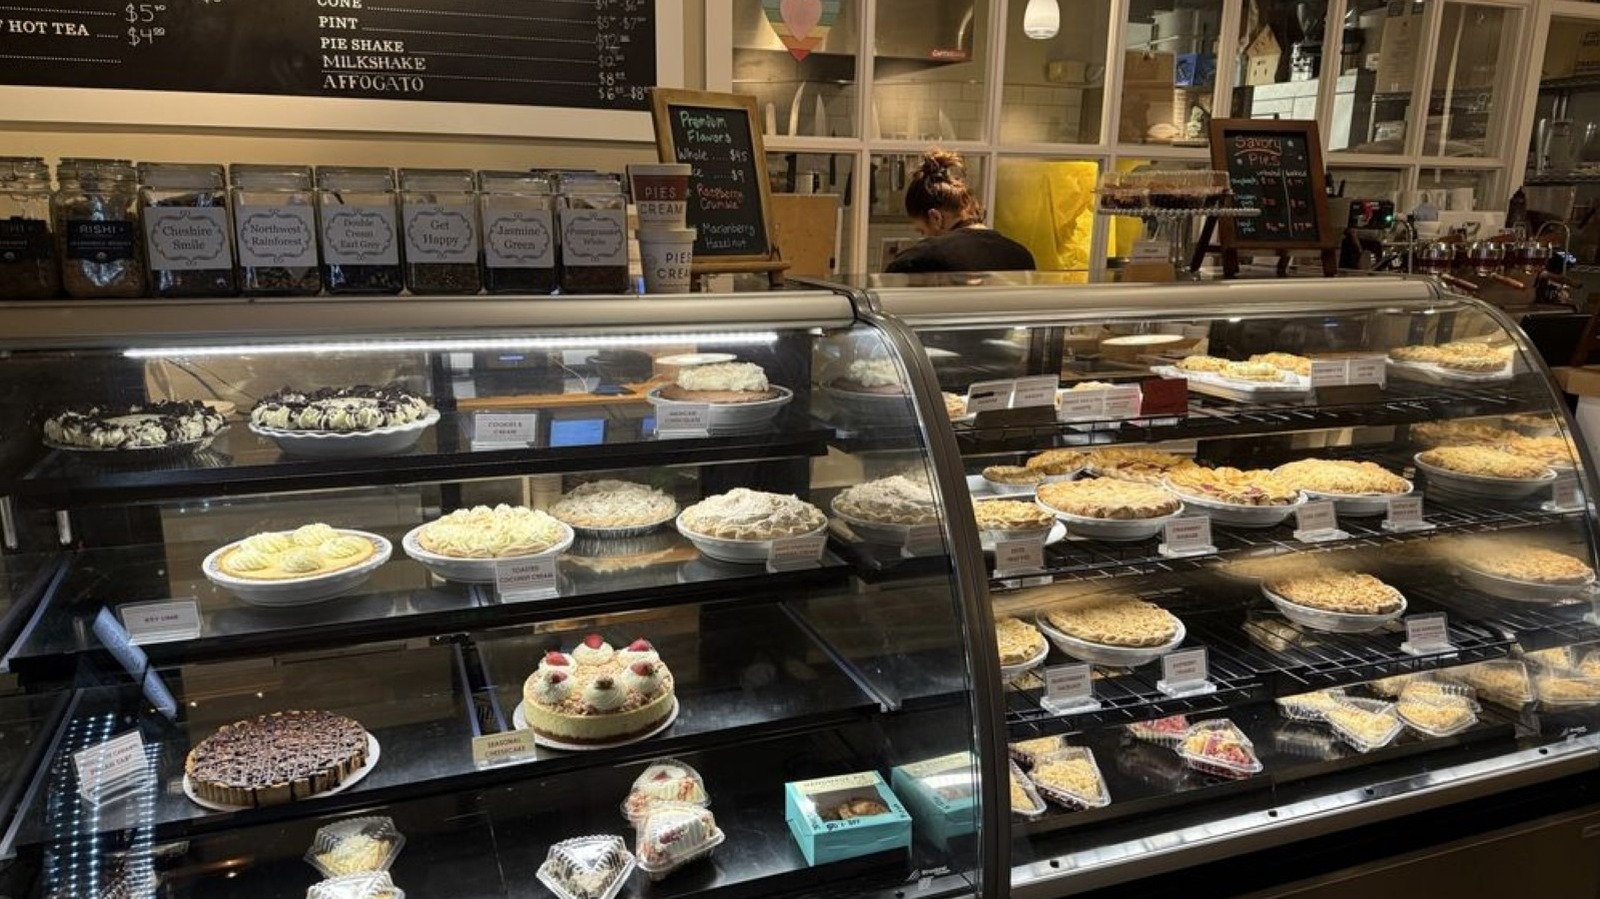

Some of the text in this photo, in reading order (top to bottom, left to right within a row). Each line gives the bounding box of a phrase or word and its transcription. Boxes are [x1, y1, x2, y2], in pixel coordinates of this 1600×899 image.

[8, 20, 47, 34] HOT
[52, 22, 90, 36] TEA
[318, 16, 359, 30] PINT
[320, 37, 404, 53] PIE SHAKE
[322, 55, 426, 70] MILKSHAKE
[323, 75, 424, 92] AFFOGATO
[680, 111, 727, 129] Premium
[687, 131, 732, 144] Flavors
[1234, 135, 1282, 152] Savory
[678, 148, 709, 161] Whole
[645, 187, 677, 199] PIES
[640, 202, 684, 215] CREAM
[79, 224, 116, 234] RISHI
[250, 224, 302, 234] Northwest
[343, 218, 374, 228] Double
[430, 220, 450, 231] Get
[162, 226, 213, 237] Cheshire
[498, 226, 541, 236] Jasmine
[173, 239, 206, 250] Smile
[251, 237, 303, 247] Rainforest
[340, 240, 380, 250] Earl Grey
[423, 234, 459, 247] Happy
[504, 240, 536, 250] Green
